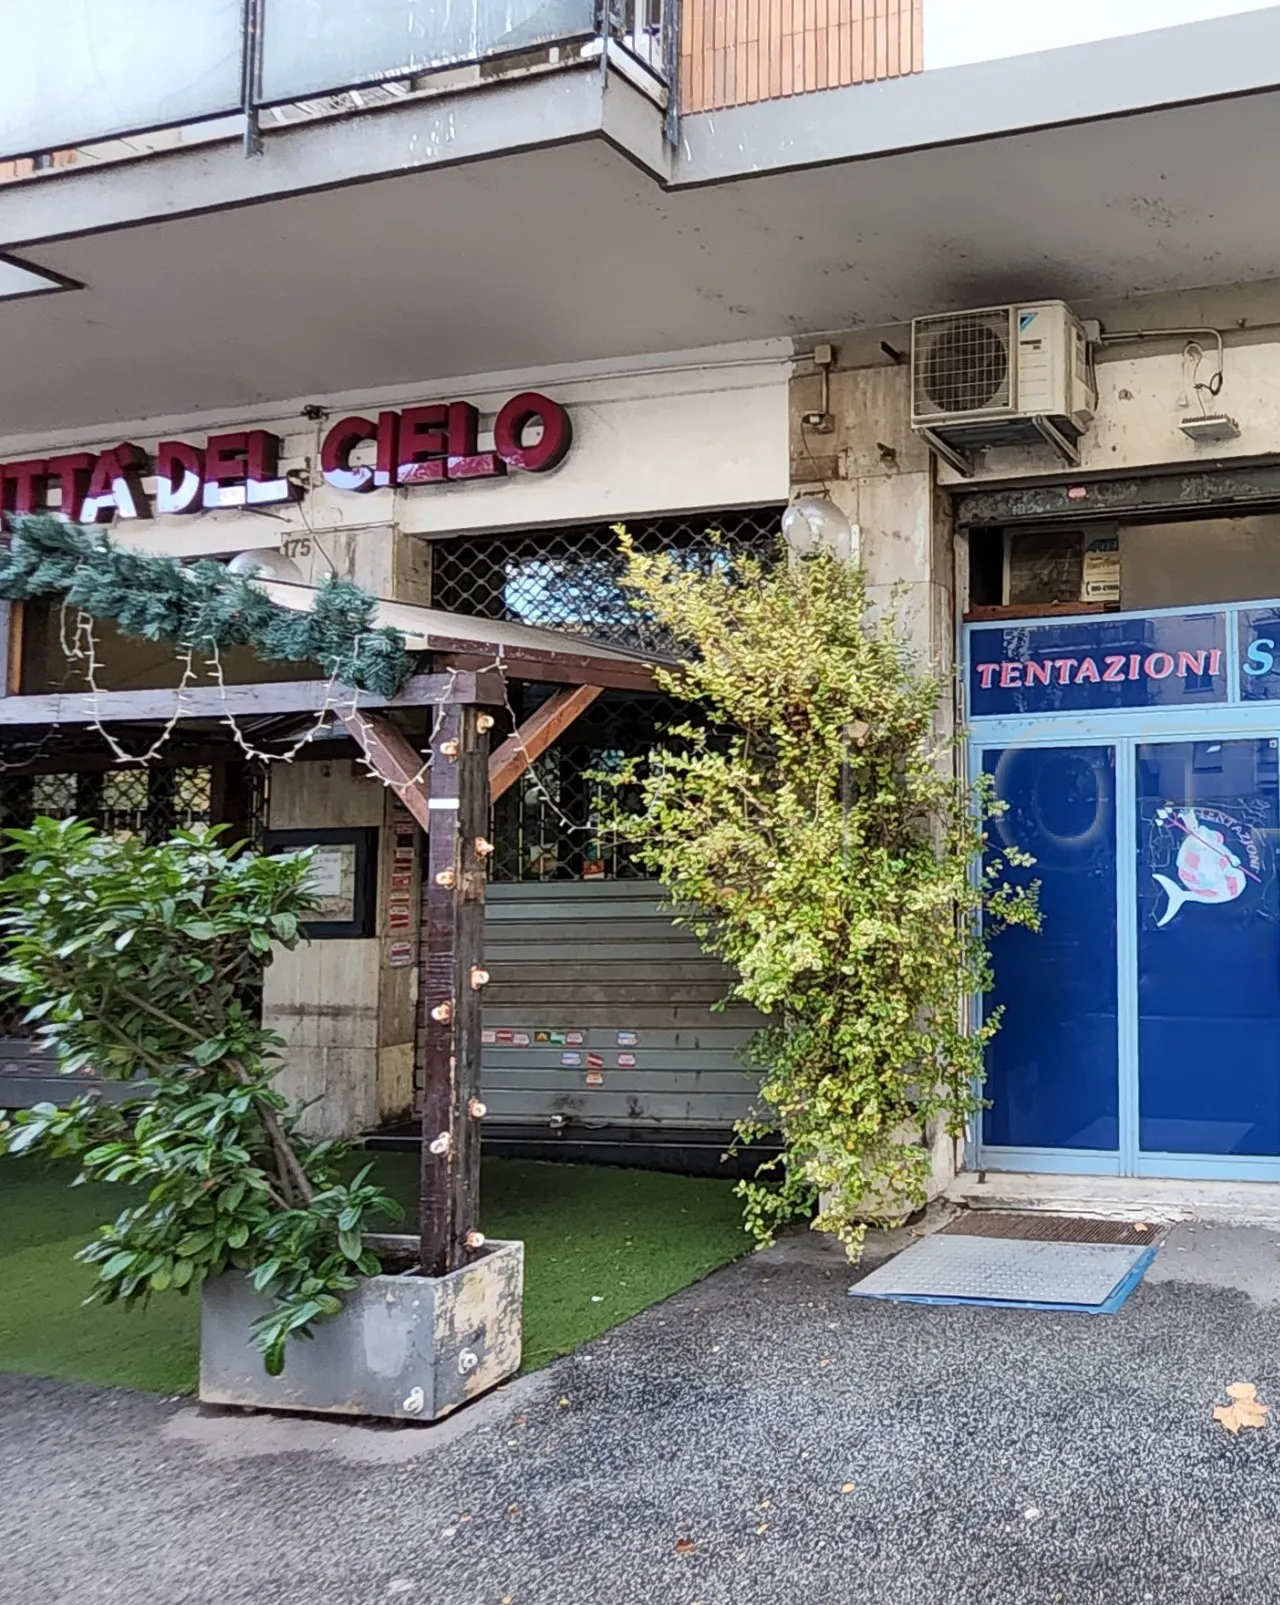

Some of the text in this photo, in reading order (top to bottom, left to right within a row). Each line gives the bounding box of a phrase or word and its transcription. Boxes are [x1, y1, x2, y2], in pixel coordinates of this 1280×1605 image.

[157, 430, 290, 515] DEL
[321, 392, 570, 493] CIELO
[282, 538, 311, 558] 175
[976, 648, 1222, 689] TENTAZIONI
